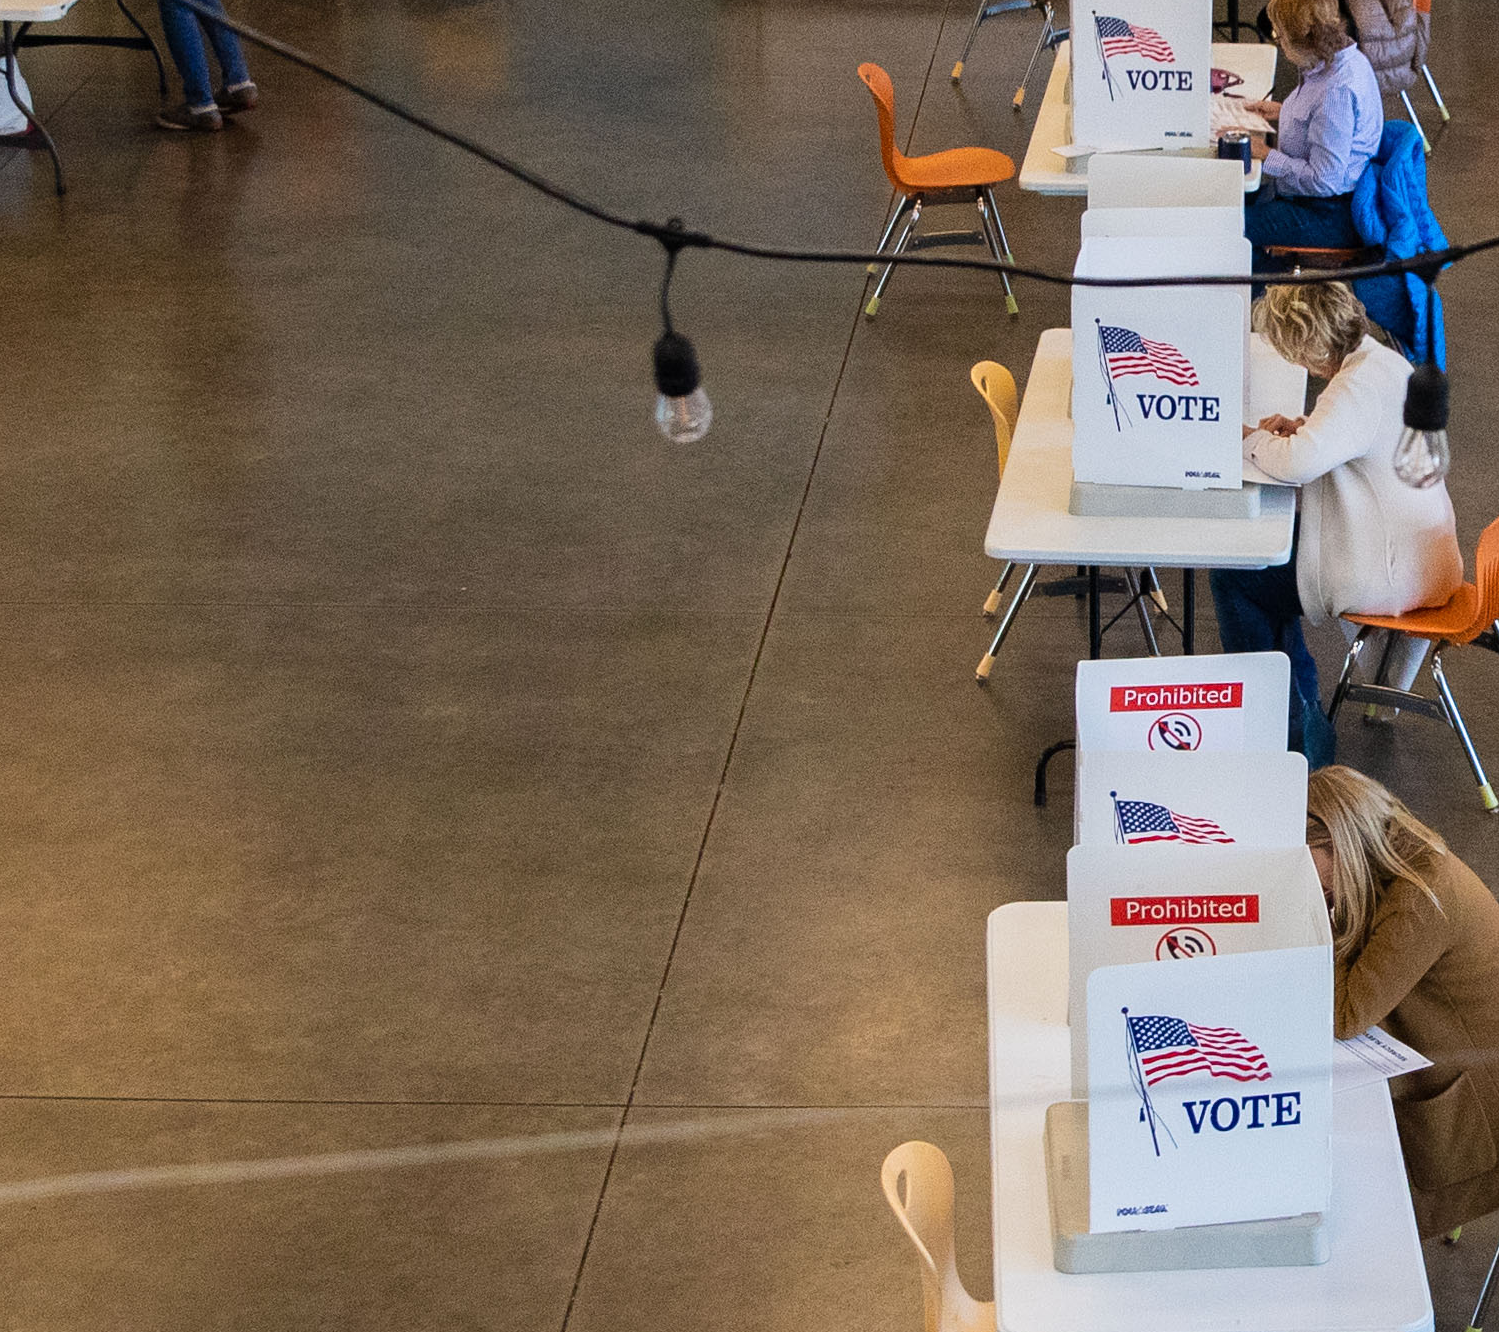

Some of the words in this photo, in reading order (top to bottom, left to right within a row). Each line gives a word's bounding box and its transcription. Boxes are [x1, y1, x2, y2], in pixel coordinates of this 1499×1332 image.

[1126, 69, 1193, 91] VOTE
[1136, 394, 1220, 422] VOTE
[1123, 685, 1233, 707] Prohibited
[1125, 898, 1247, 920] Prohibited
[1182, 1091, 1301, 1134] VOTE
